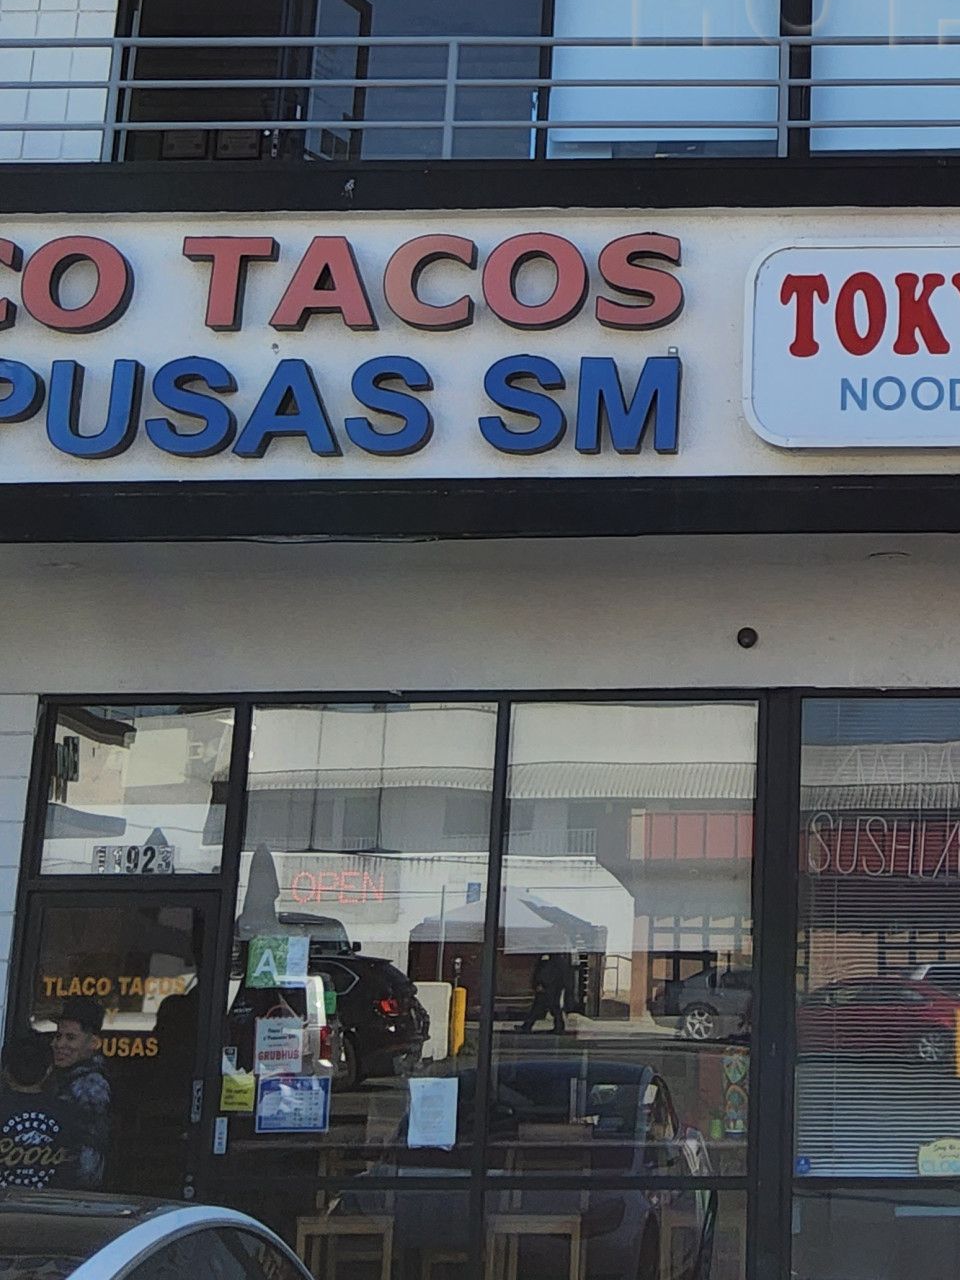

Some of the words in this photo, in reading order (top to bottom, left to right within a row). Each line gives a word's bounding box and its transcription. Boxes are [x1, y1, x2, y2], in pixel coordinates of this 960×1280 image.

[183, 231, 686, 333] TACOS
[478, 353, 683, 457] SM
[290, 871, 384, 905] OPEN
[254, 948, 279, 977] A
[43, 975, 112, 996] TLACO
[118, 976, 187, 995] TACOS
